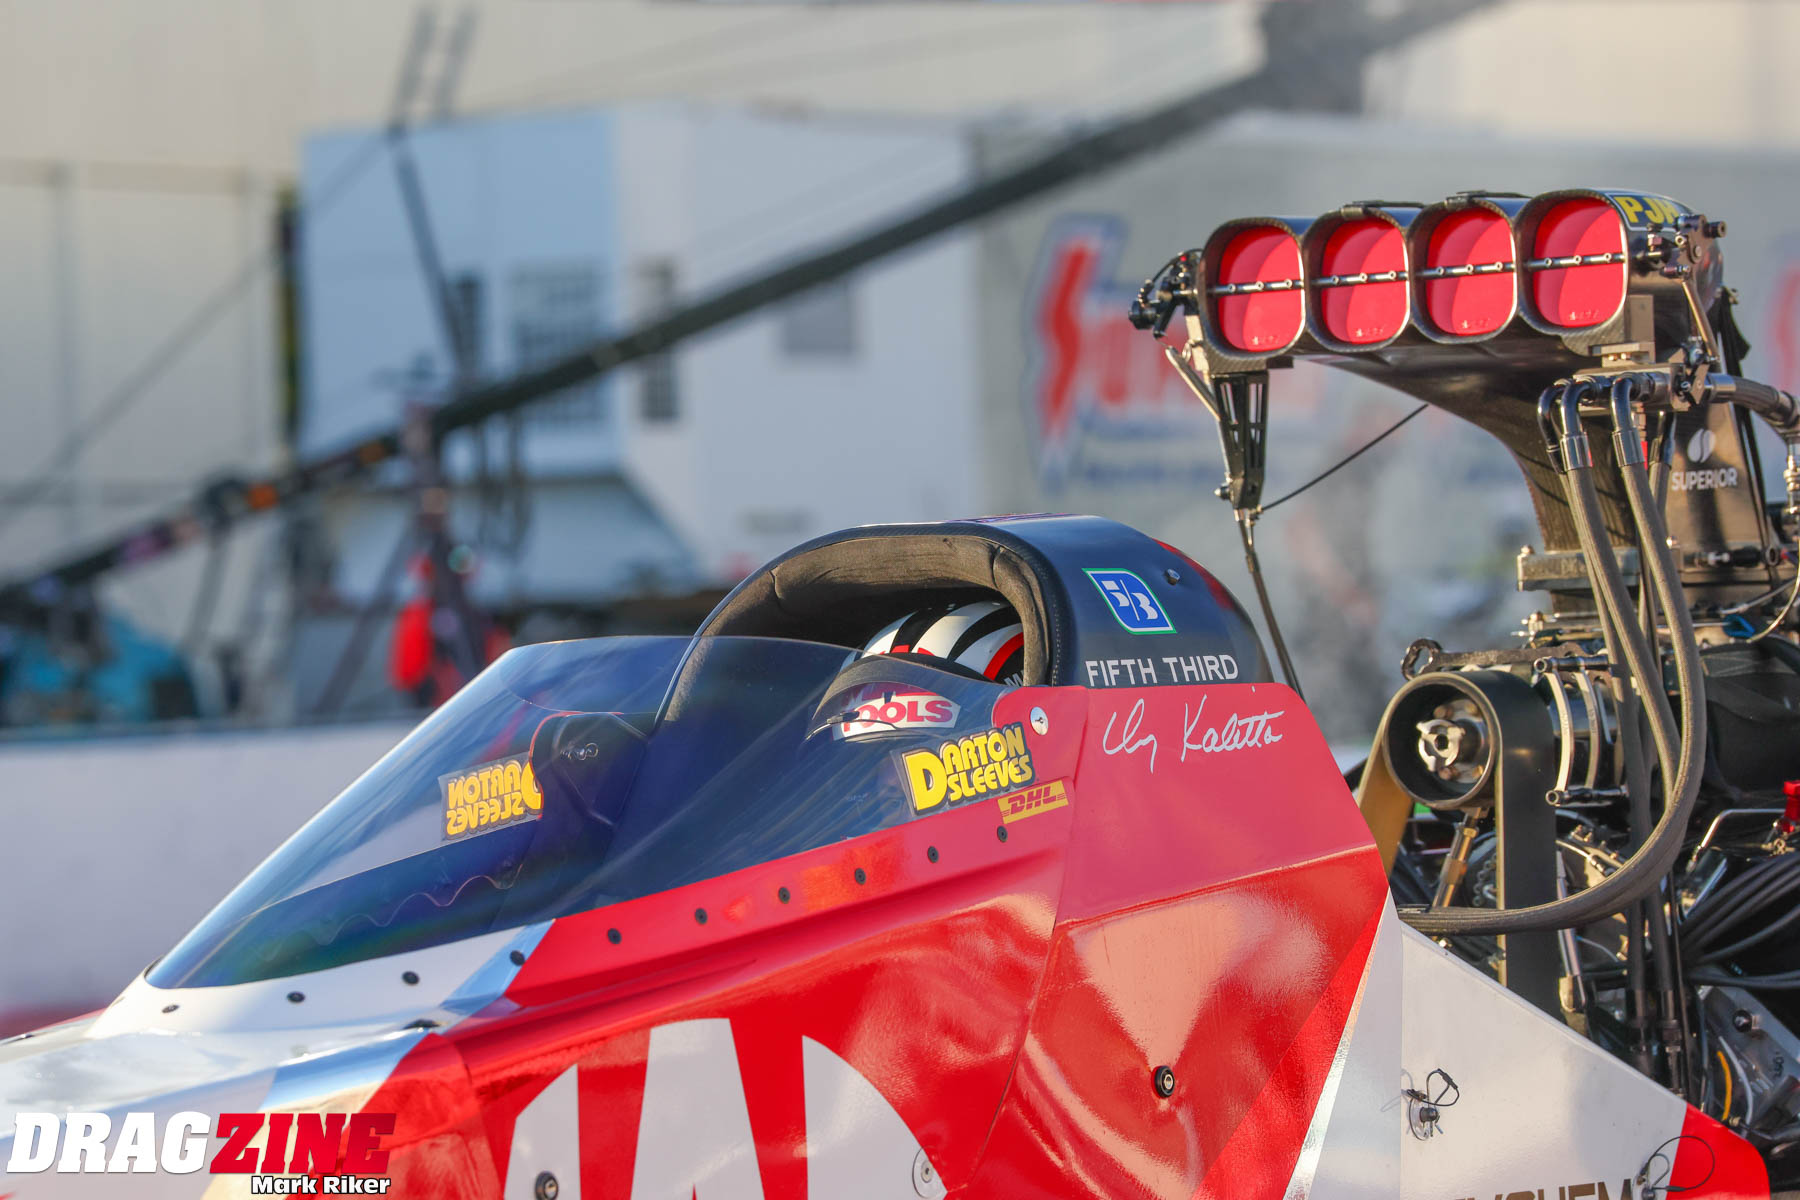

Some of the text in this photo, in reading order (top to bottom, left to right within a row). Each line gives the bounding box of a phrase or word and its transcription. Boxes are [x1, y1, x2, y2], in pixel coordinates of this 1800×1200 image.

[1671, 467, 1738, 491] SUPERIOR
[1085, 654, 1239, 687] FIFTH THIRD
[902, 724, 1026, 811] DARTON
[947, 755, 1033, 801] SLEEVES
[1008, 786, 1057, 815] DHL
